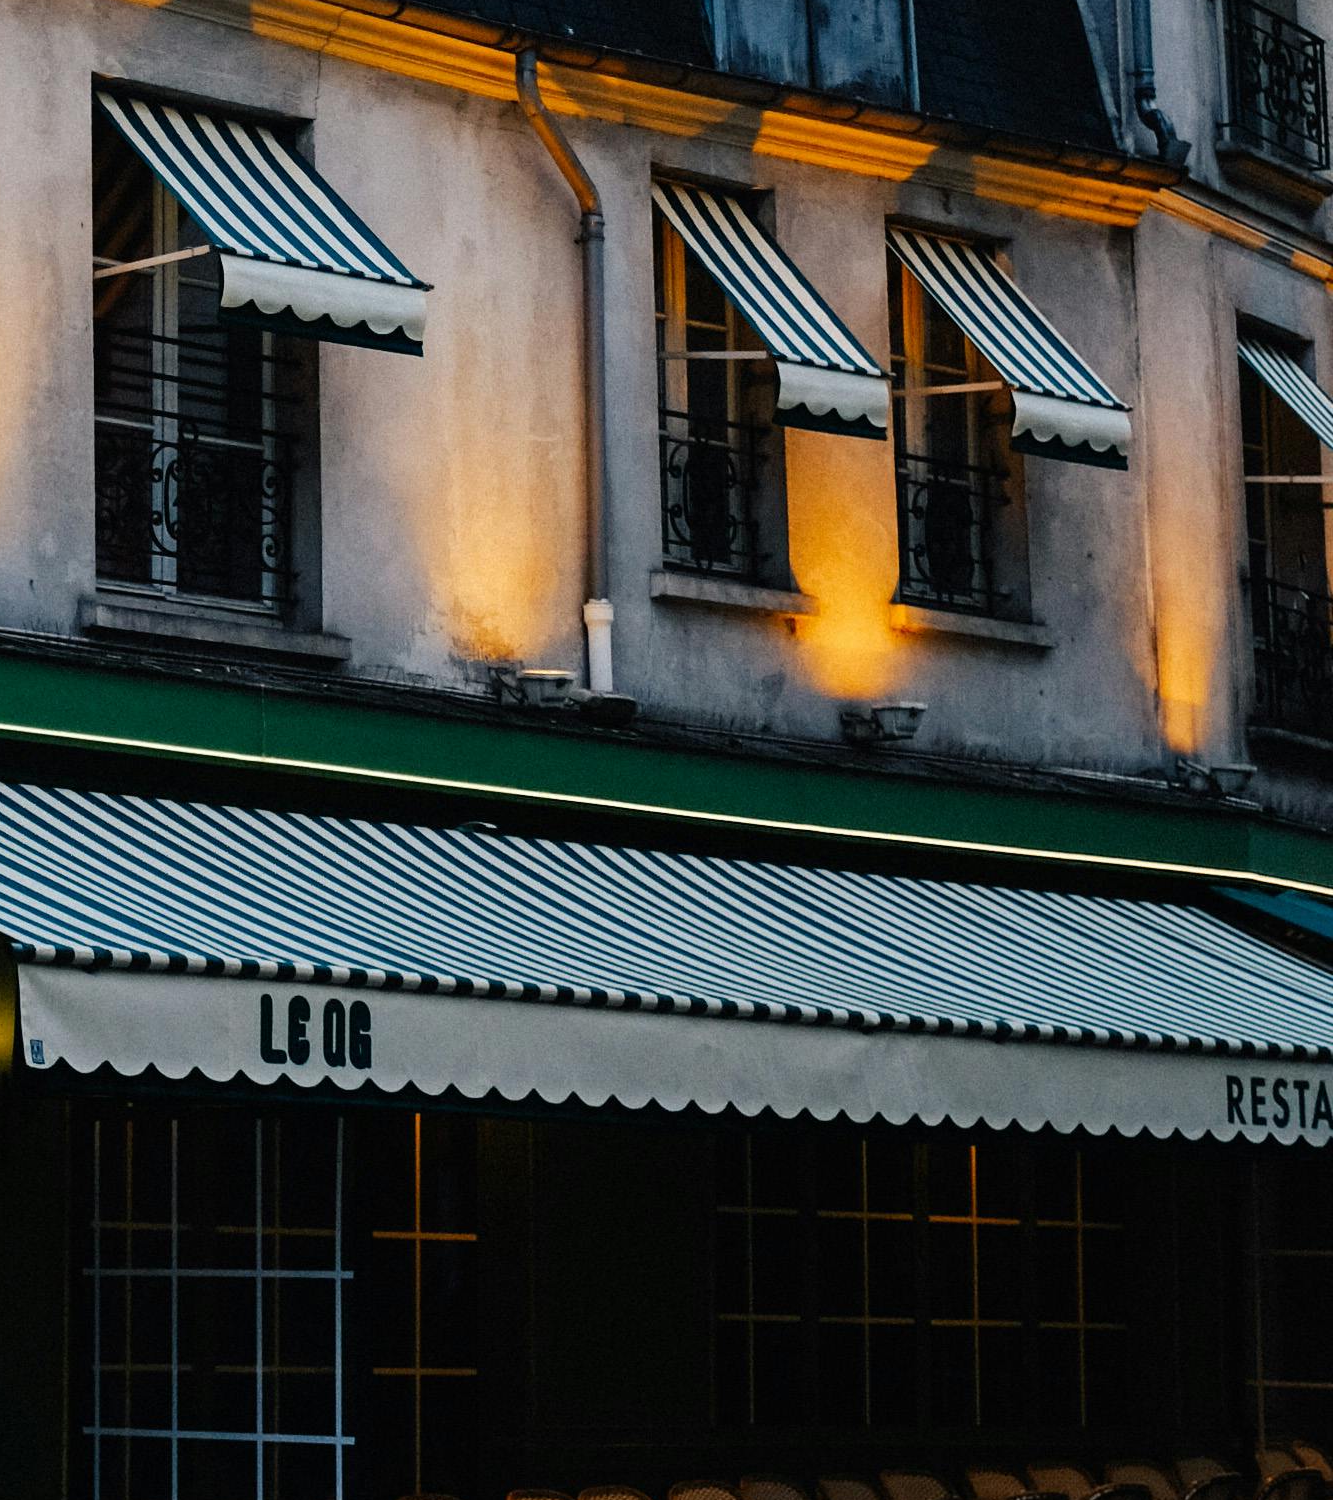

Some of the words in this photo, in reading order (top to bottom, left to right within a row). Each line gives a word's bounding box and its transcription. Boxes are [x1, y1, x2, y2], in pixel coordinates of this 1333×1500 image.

[260, 993, 311, 1066] LE
[323, 998, 372, 1070] QG
[1226, 1074, 1333, 1130] RESTA
